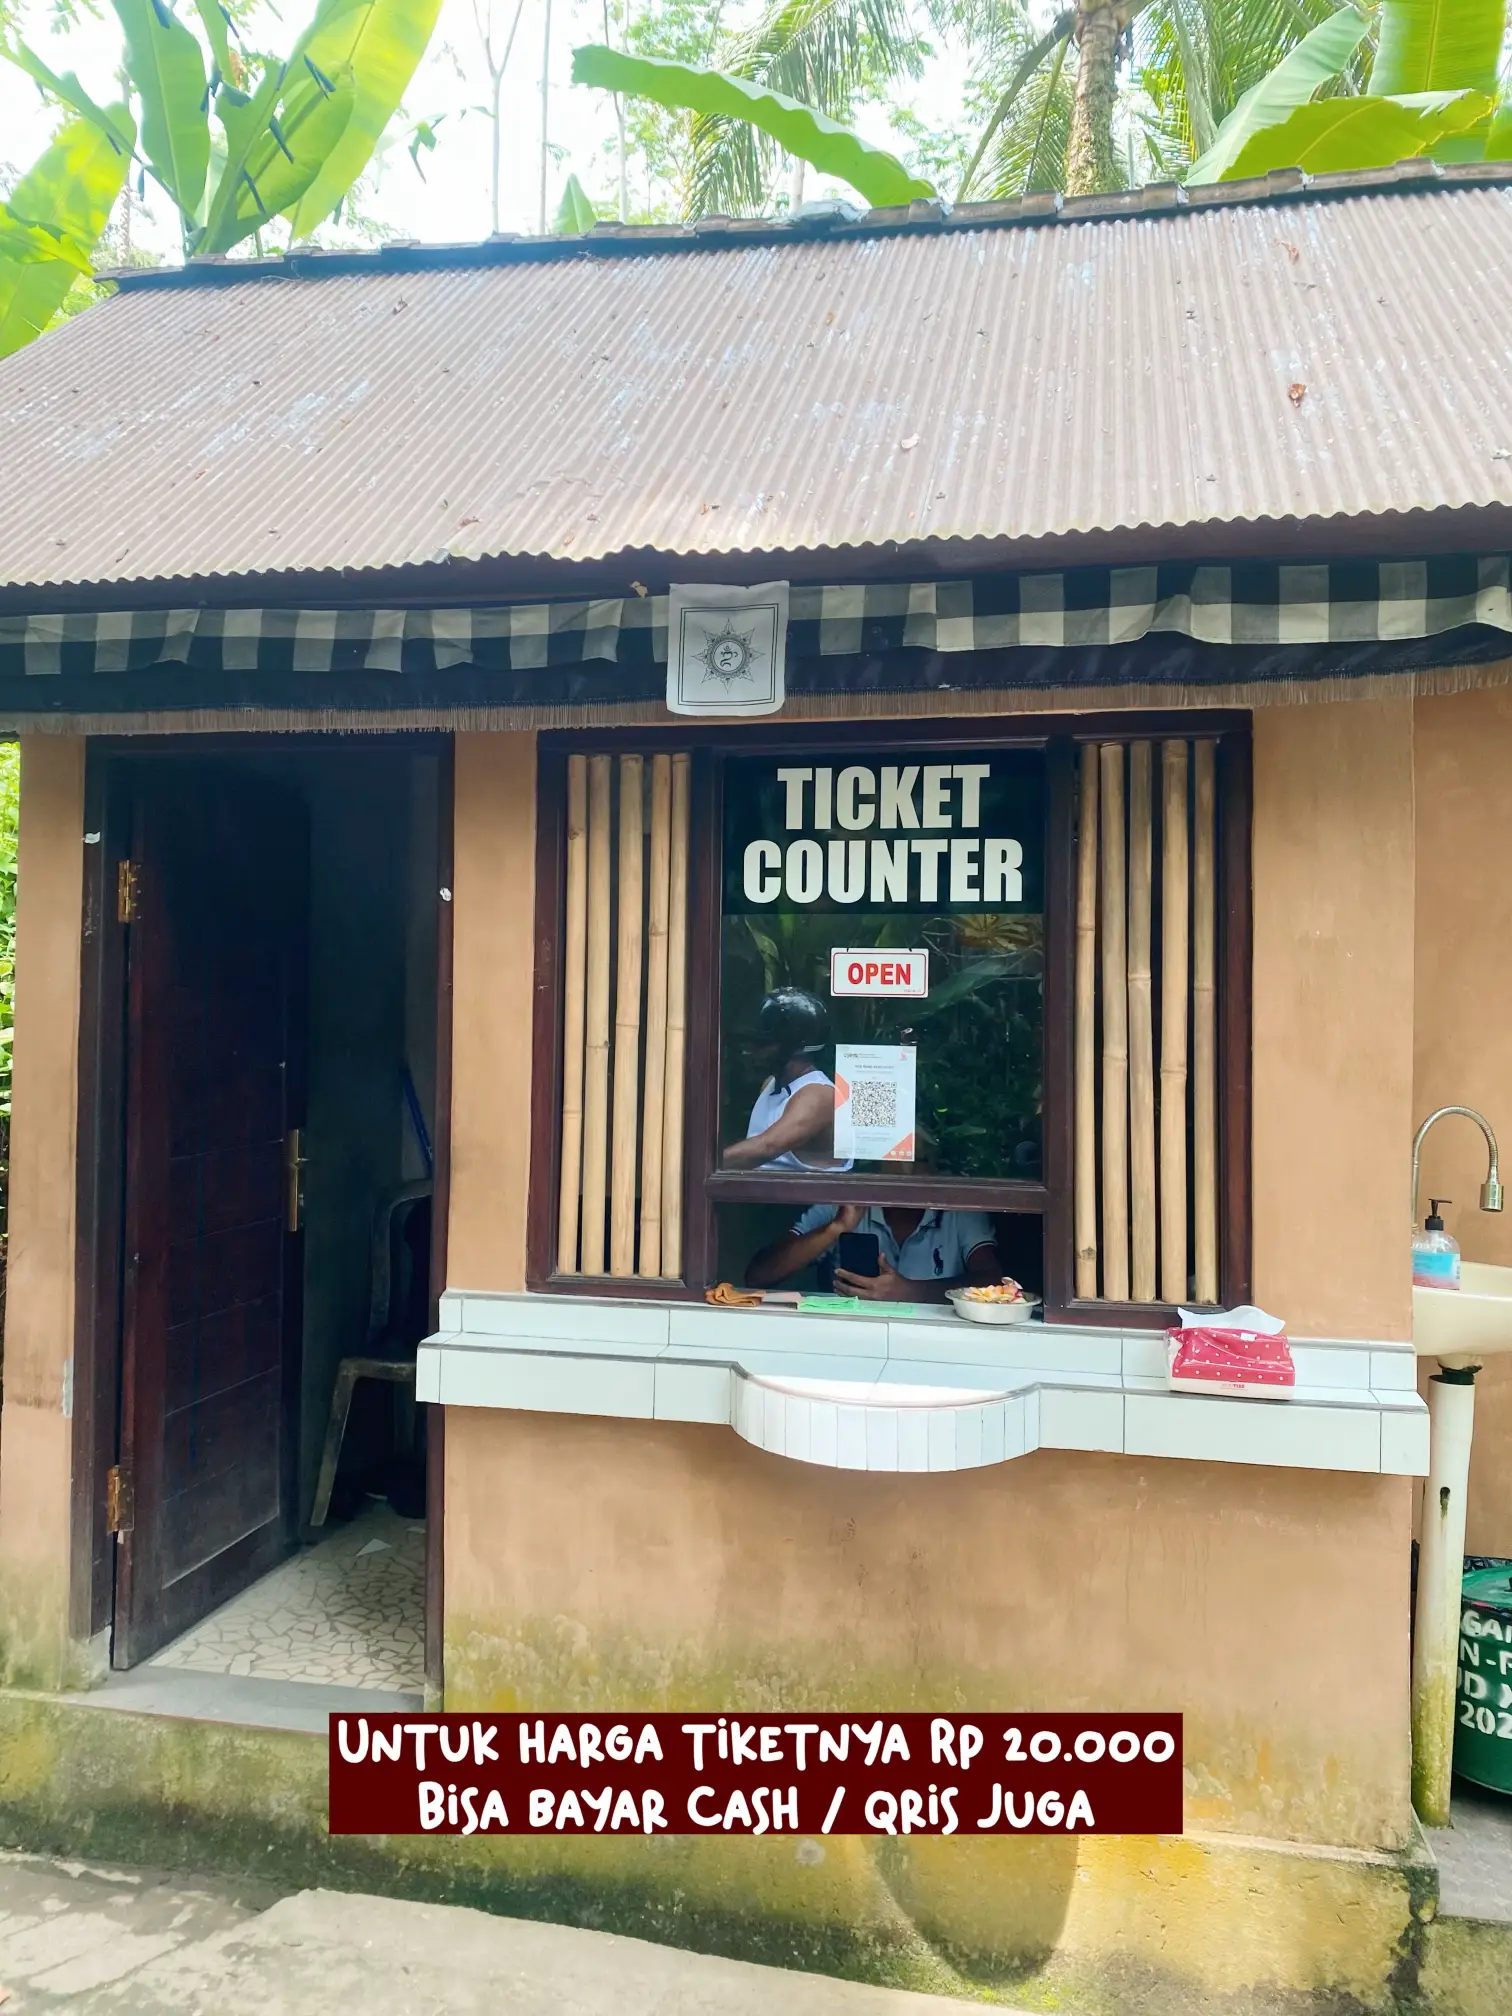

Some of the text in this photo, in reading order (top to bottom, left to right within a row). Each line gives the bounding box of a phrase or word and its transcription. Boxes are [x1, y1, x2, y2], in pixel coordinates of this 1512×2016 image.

[777, 764, 990, 831] TICKET
[743, 838, 1023, 904] COUNTER
[847, 962, 911, 985] OPEN
